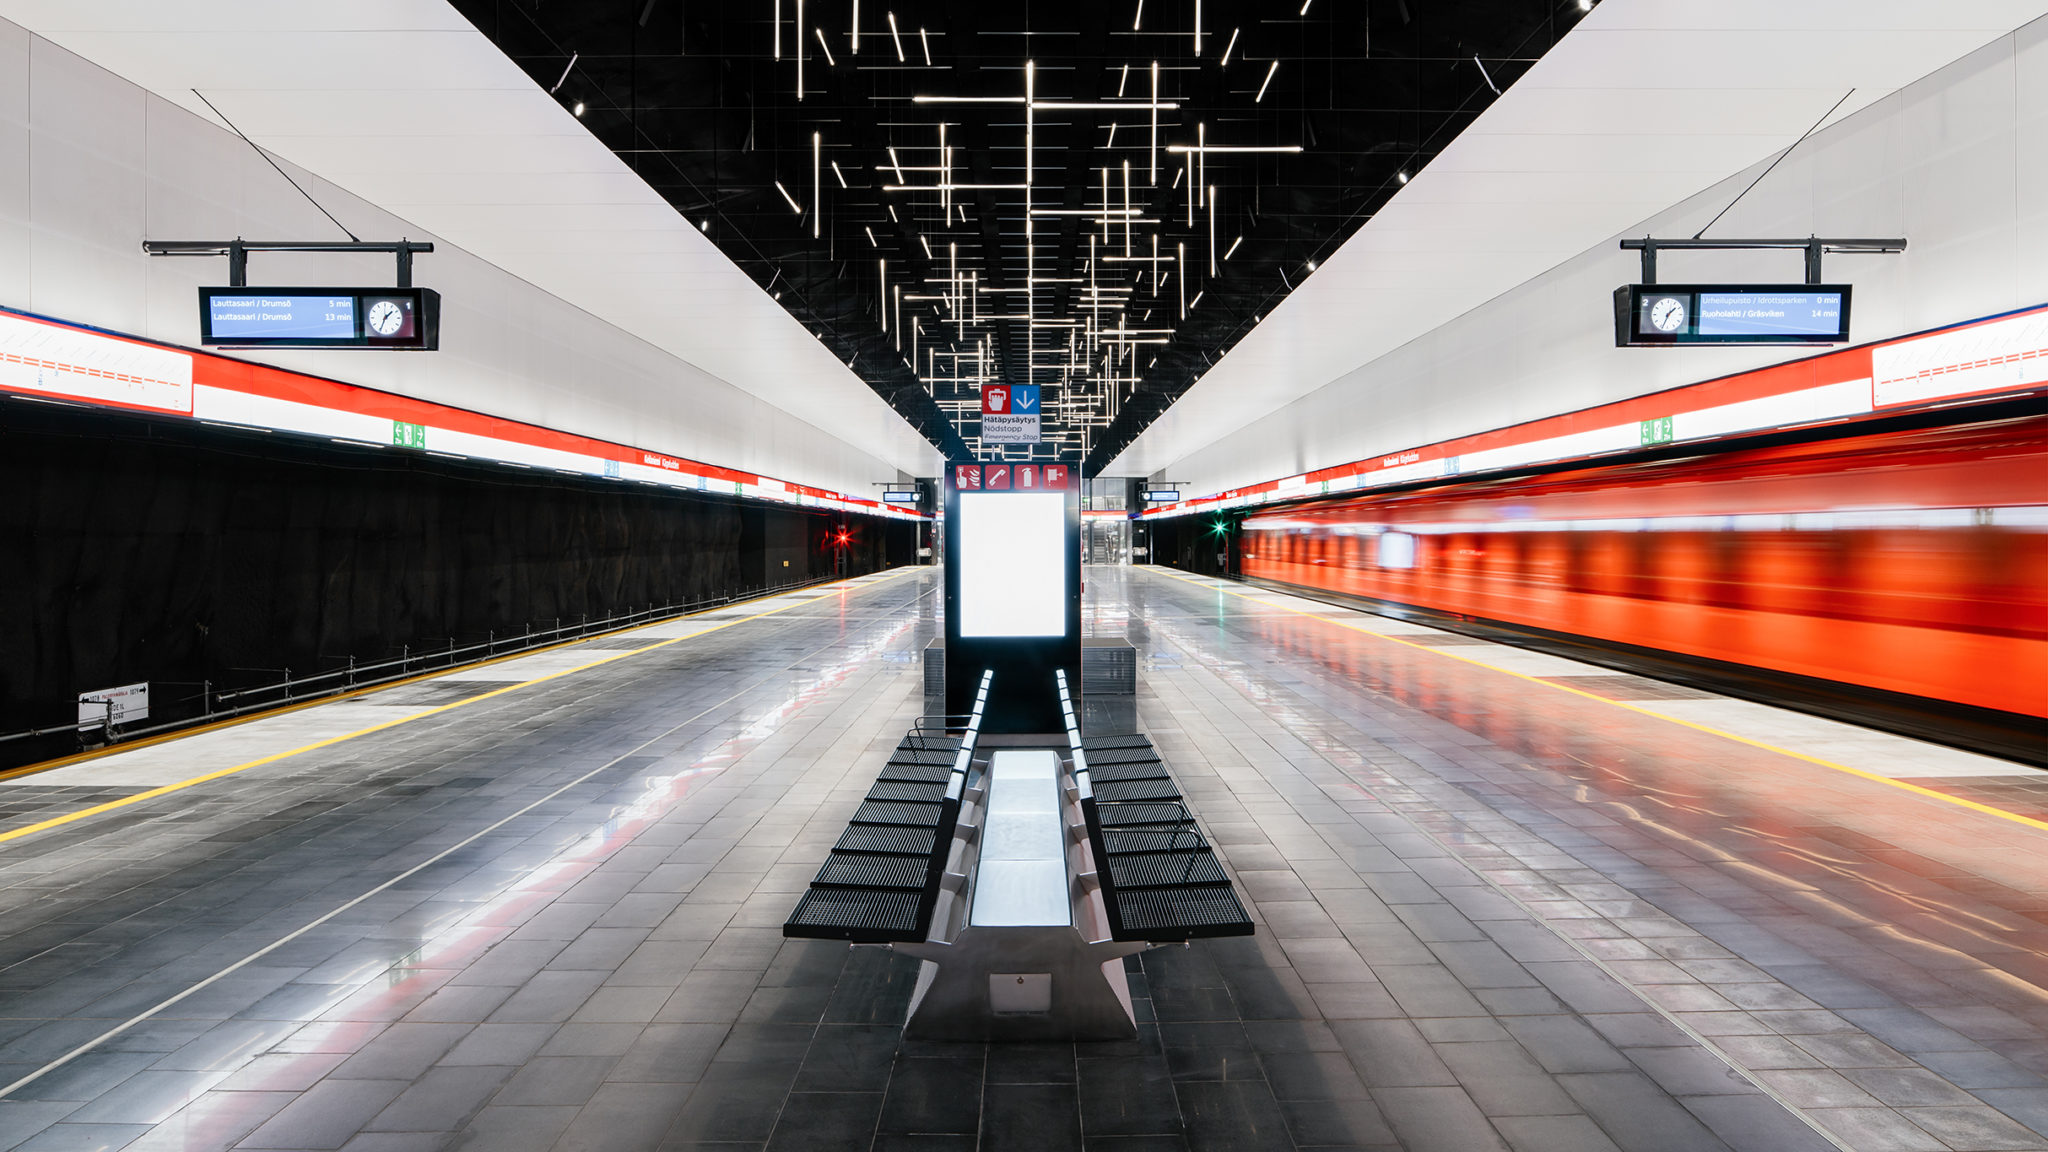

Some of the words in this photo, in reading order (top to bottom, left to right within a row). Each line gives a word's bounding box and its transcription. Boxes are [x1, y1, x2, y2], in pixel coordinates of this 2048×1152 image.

[212, 300, 255, 308] Lauttasaari
[336, 300, 351, 308] min
[1642, 299, 1648, 307] 2
[213, 313, 256, 321] Lauttasaari
[325, 313, 335, 321] 13
[337, 313, 352, 321] min
[1702, 310, 1741, 318] Ruoholahti
[1811, 310, 1821, 318] 14
[1823, 310, 1838, 318] min
[984, 416, 1036, 424] Hätäpysäytys
[1022, 433, 1038, 441] Stop
